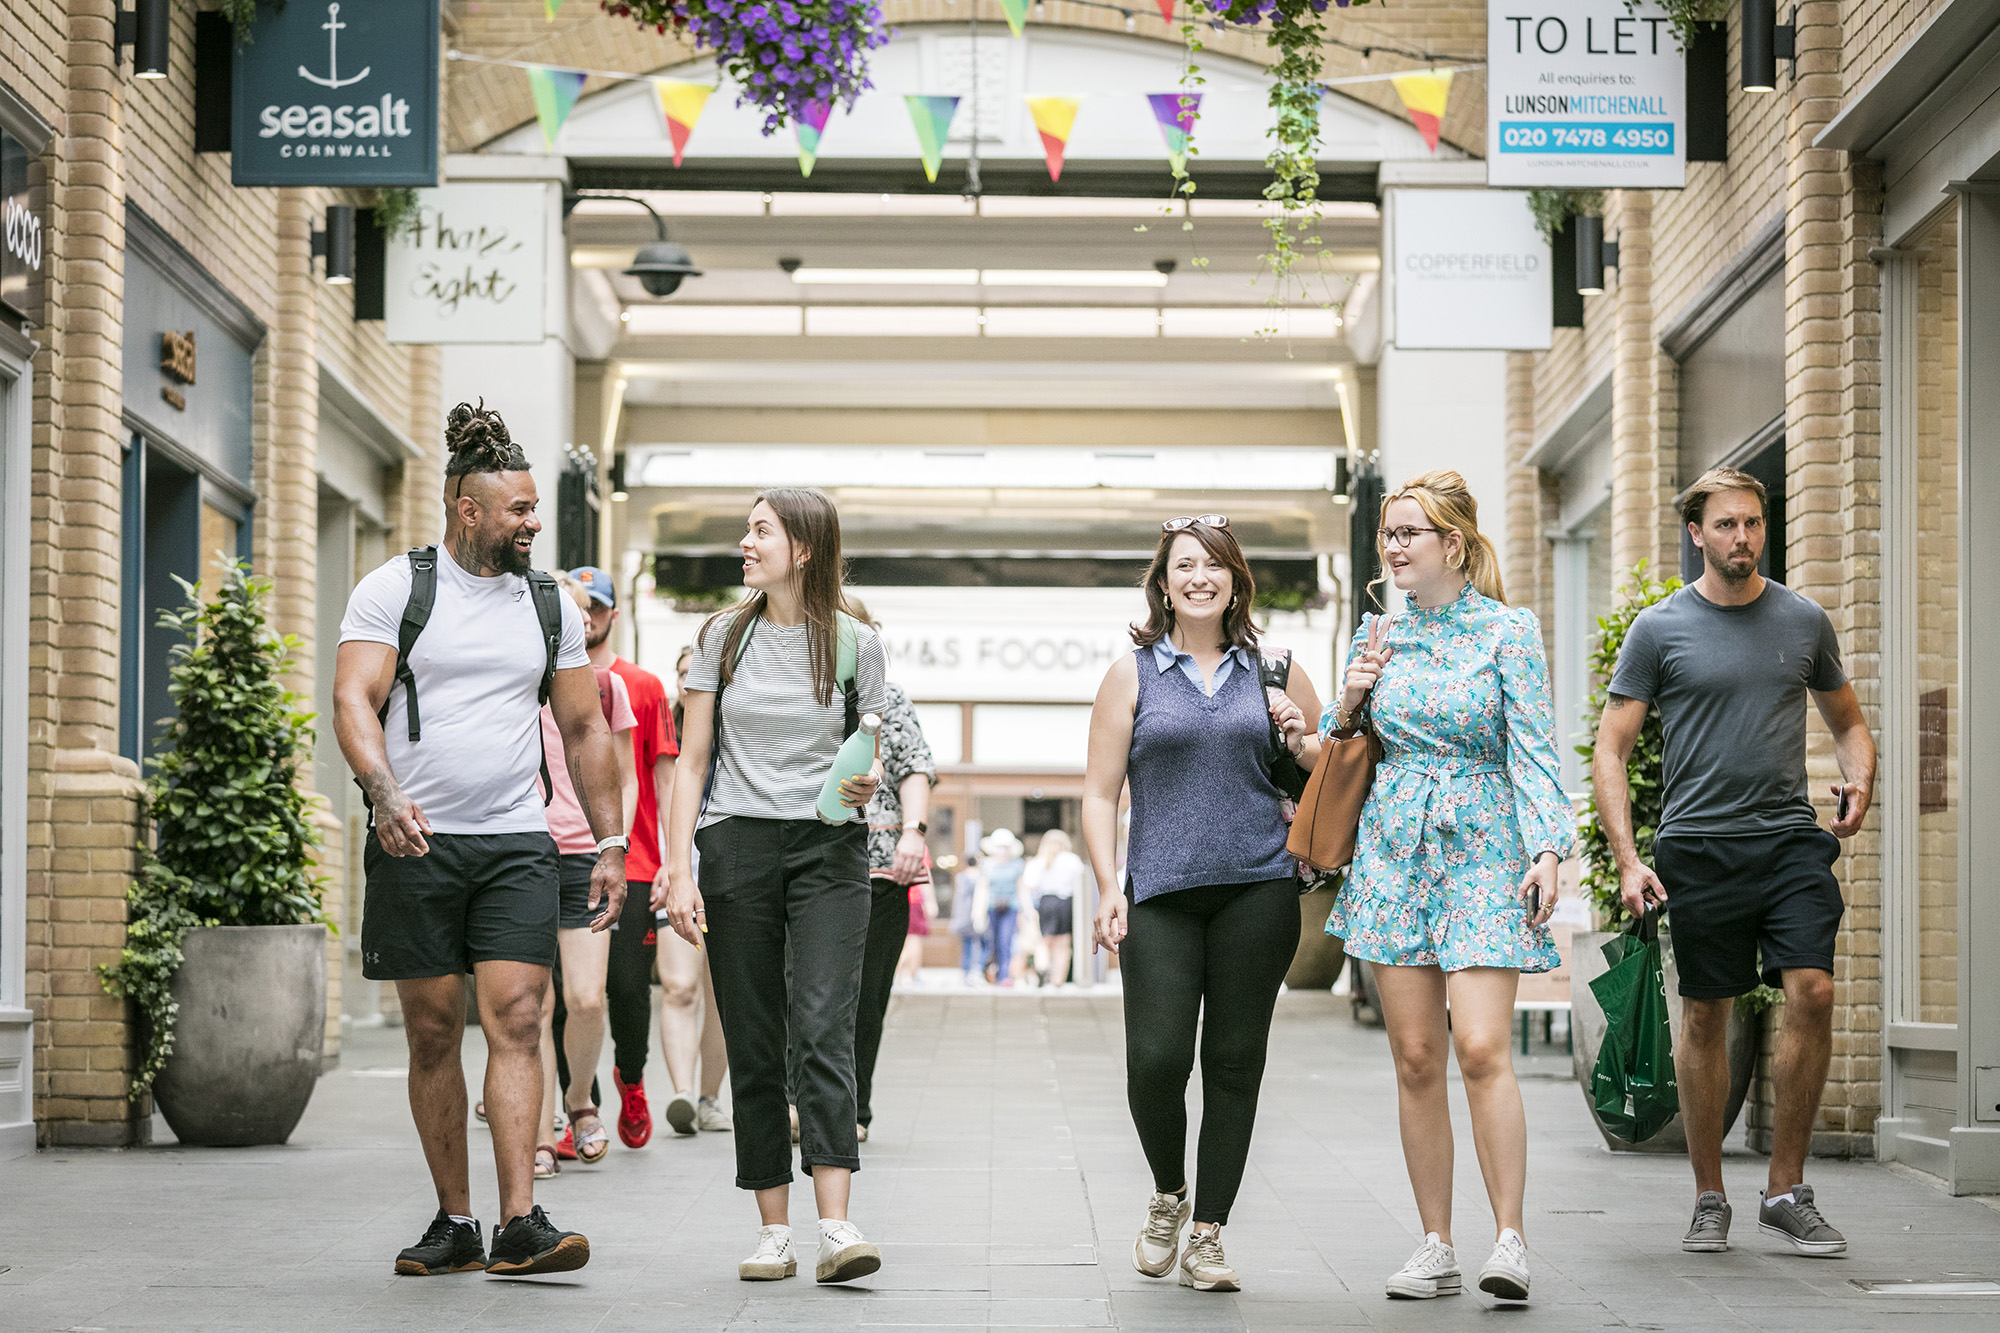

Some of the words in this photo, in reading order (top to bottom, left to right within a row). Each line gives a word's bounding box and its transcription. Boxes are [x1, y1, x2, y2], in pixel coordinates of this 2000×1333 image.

[1505, 16, 1568, 54] TO
[1586, 16, 1668, 55] LET
[1538, 72, 1555, 84] All
[1557, 72, 1616, 86] enquiries
[1618, 73, 1636, 85] to:
[258, 92, 412, 139] seasalt
[1505, 94, 1668, 116] LUNSONMITCHENALL
[1504, 127, 1547, 147] 020
[1551, 127, 1607, 147] 7478
[1611, 128, 1669, 148] 4950
[279, 144, 392, 158] CORNWALL
[6, 195, 41, 271] ecco
[1404, 253, 1540, 272] COPPERFIELD
[884, 638, 960, 668] M&S
